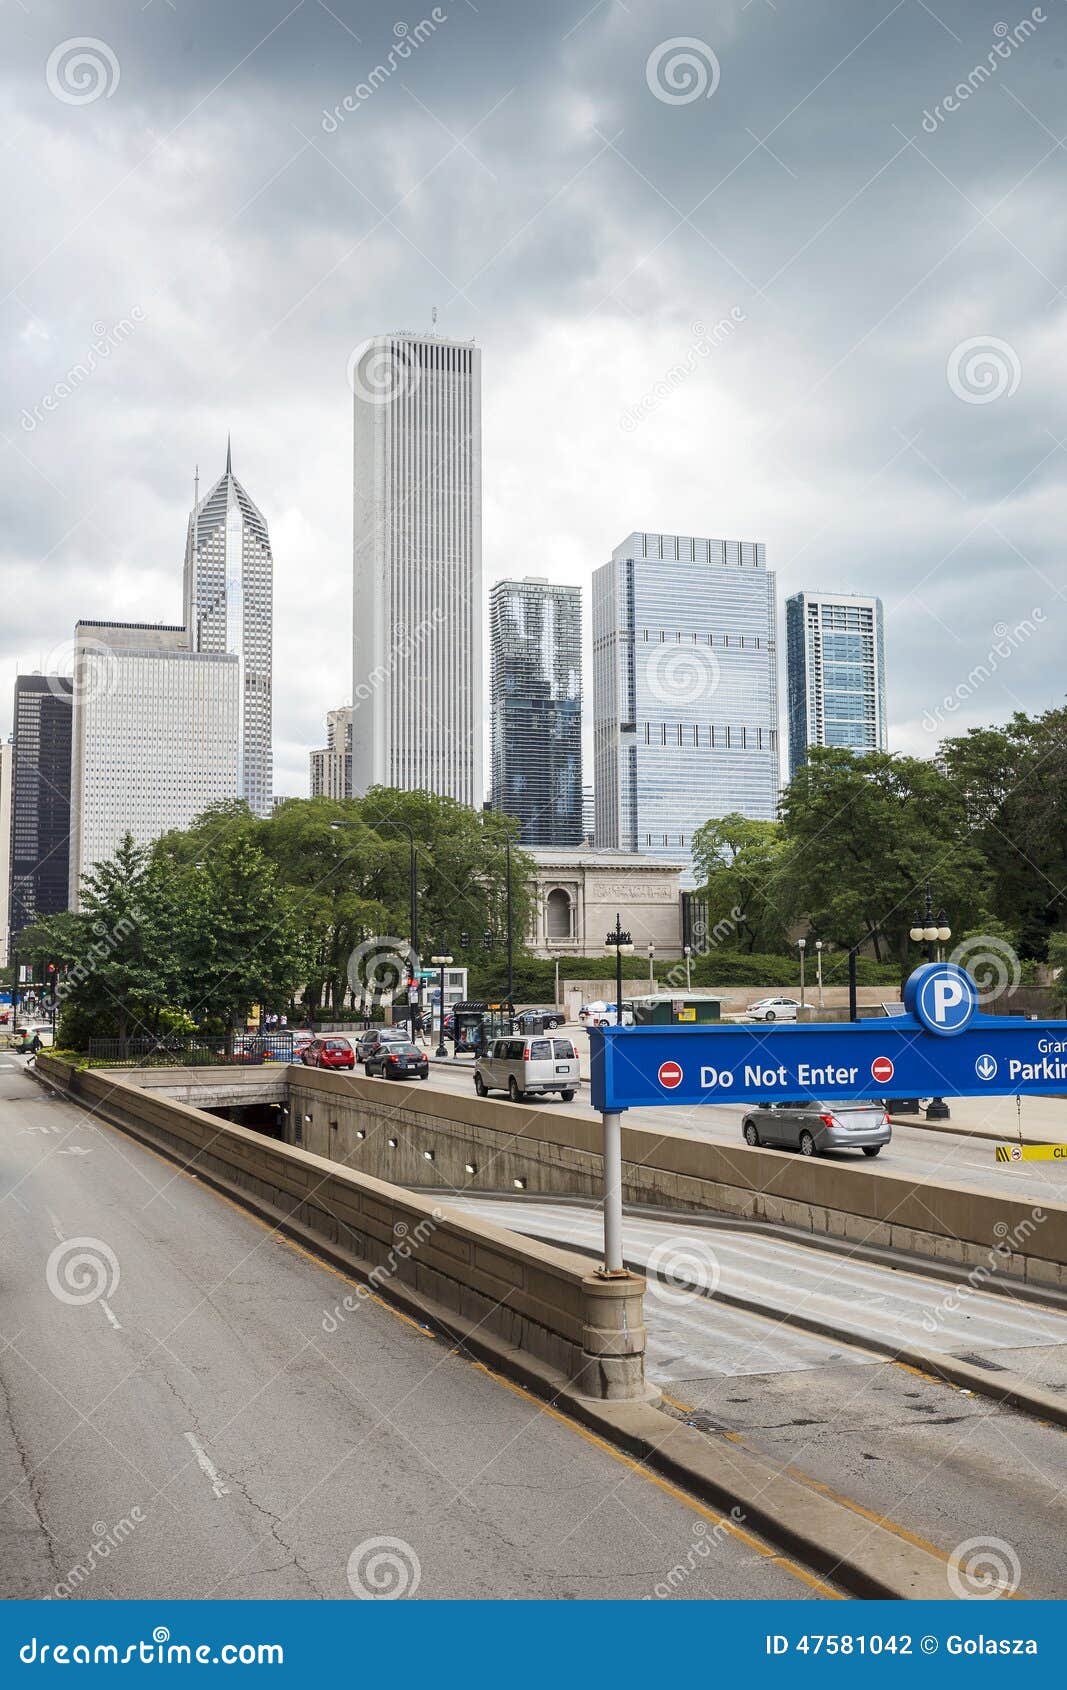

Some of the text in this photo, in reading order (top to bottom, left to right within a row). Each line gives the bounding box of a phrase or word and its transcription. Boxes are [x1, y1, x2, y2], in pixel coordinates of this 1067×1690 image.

[934, 979, 963, 1022] P
[700, 1063, 858, 1088] Do Not Enter
[1053, 1147, 1067, 1158] CL
